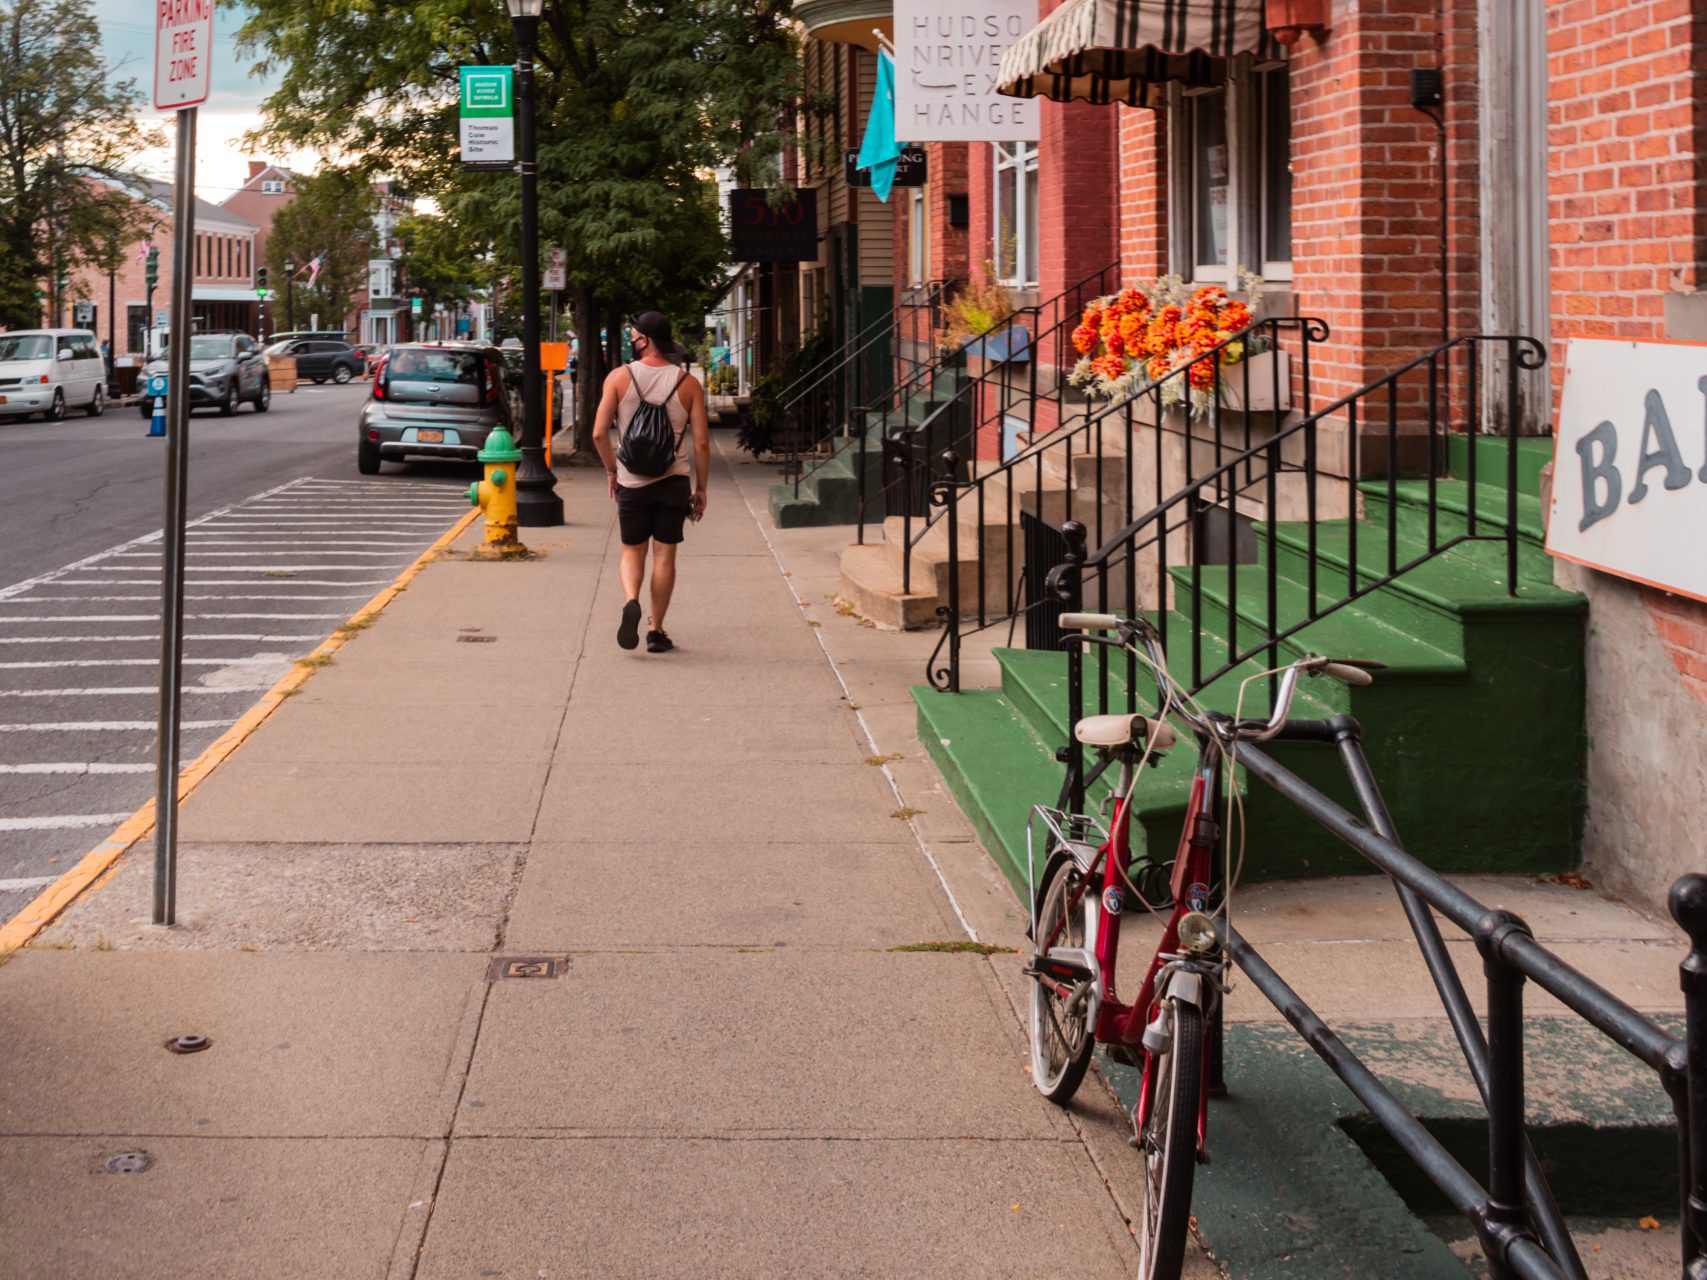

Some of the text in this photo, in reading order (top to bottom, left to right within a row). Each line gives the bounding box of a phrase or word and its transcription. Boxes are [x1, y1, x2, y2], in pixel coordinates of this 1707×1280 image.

[912, 14, 1022, 38] HUDSO
[172, 29, 196, 54] FIRE
[912, 44, 1014, 67] NRIVE
[169, 56, 198, 82] ZONE
[963, 73, 998, 96] EX
[914, 102, 1025, 126] HANGE
[1576, 374, 1707, 533] BA
